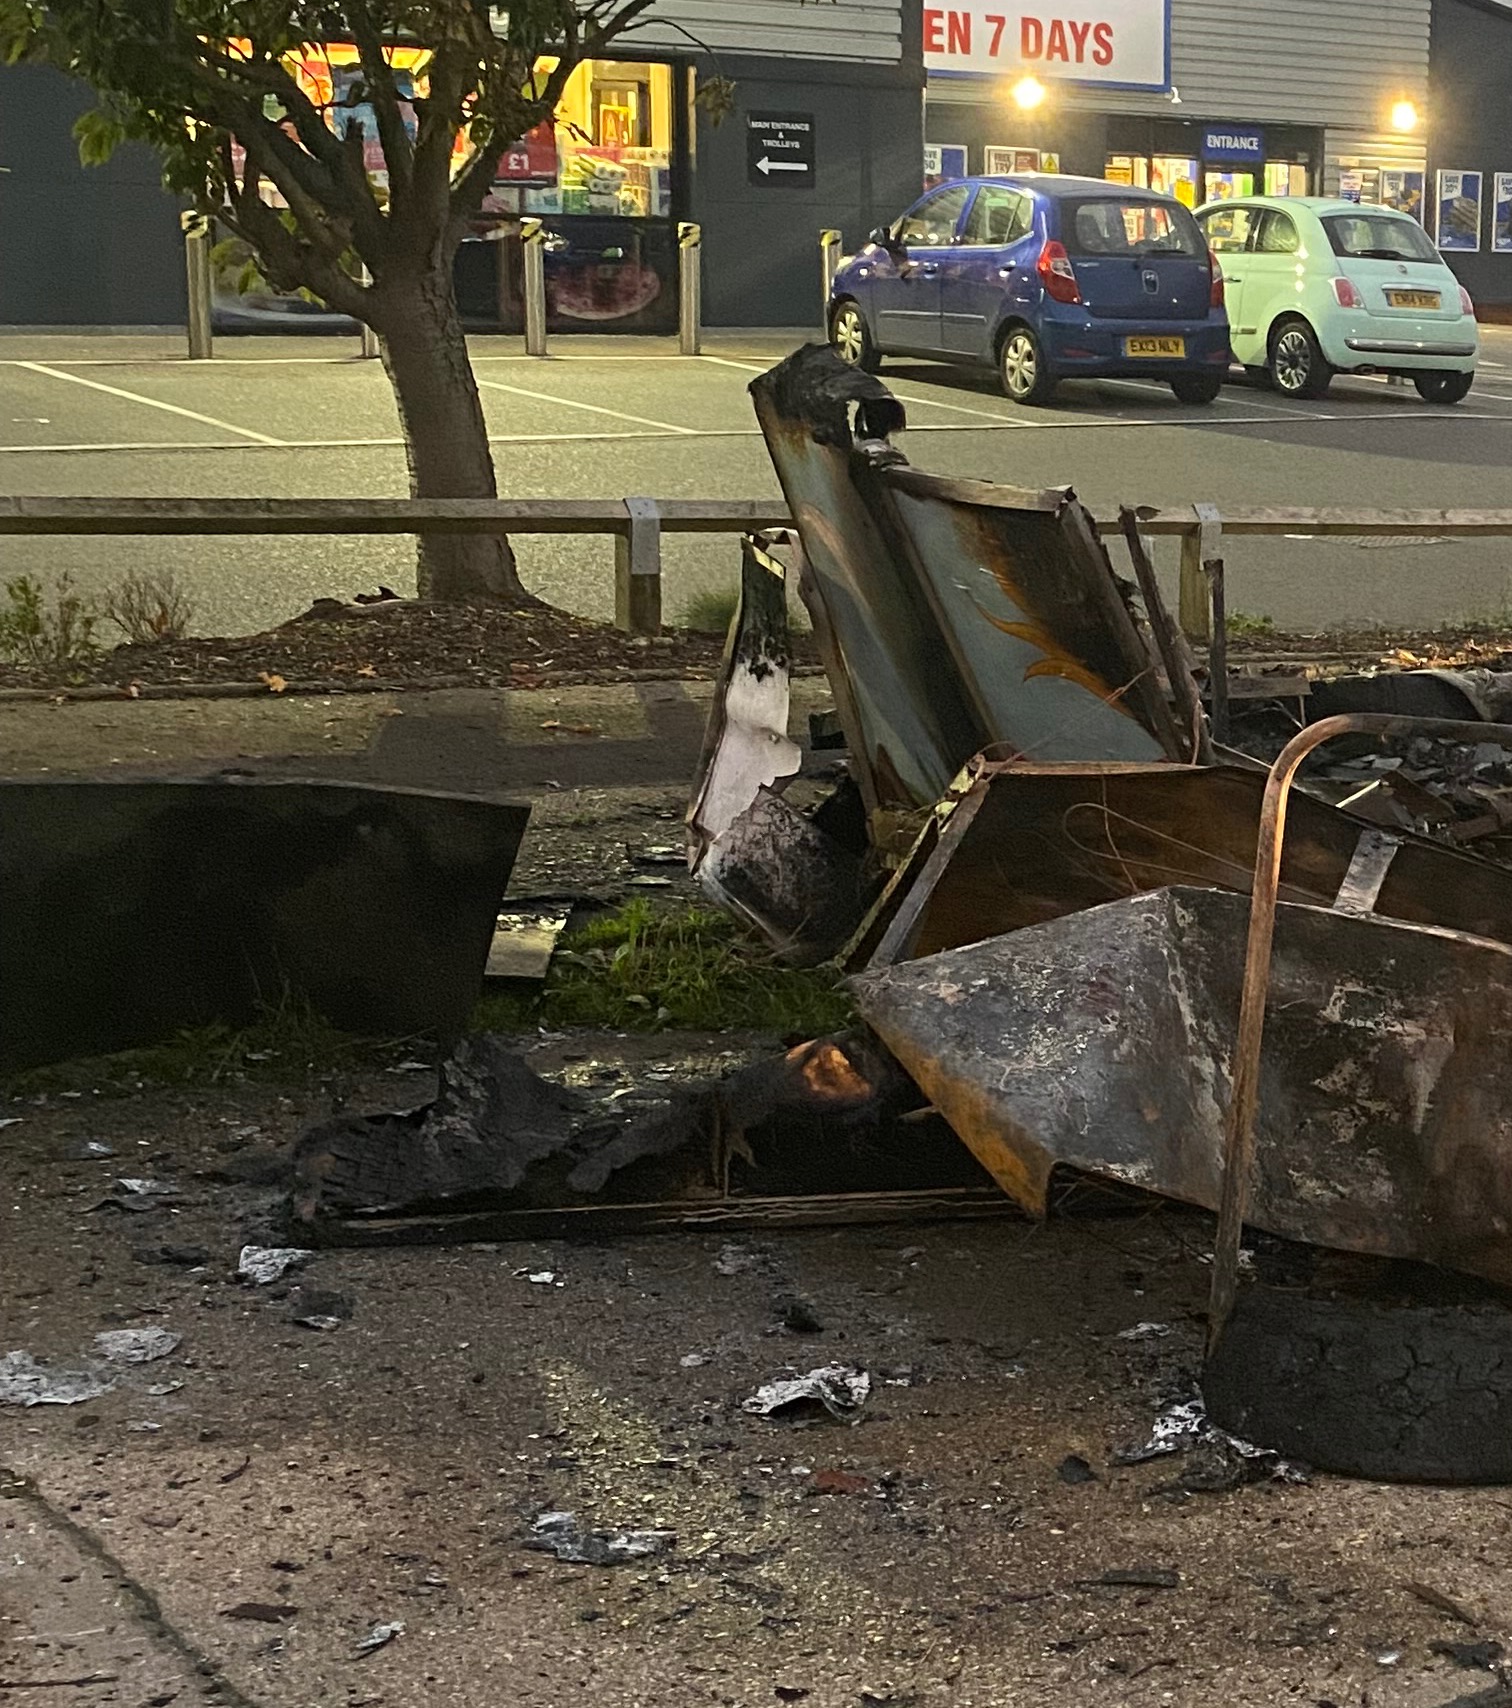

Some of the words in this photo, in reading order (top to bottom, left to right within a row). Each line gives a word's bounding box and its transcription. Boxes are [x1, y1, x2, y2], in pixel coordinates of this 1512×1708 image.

[985, 14, 1006, 57] 7
[1020, 16, 1114, 66] DAYS
[751, 121, 769, 129] MAIN
[771, 122, 810, 131] ENTRANCE
[778, 131, 785, 139] &
[762, 139, 800, 149] TROLLEYS
[1207, 134, 1259, 150] ENTRANCE
[508, 153, 530, 171] £1
